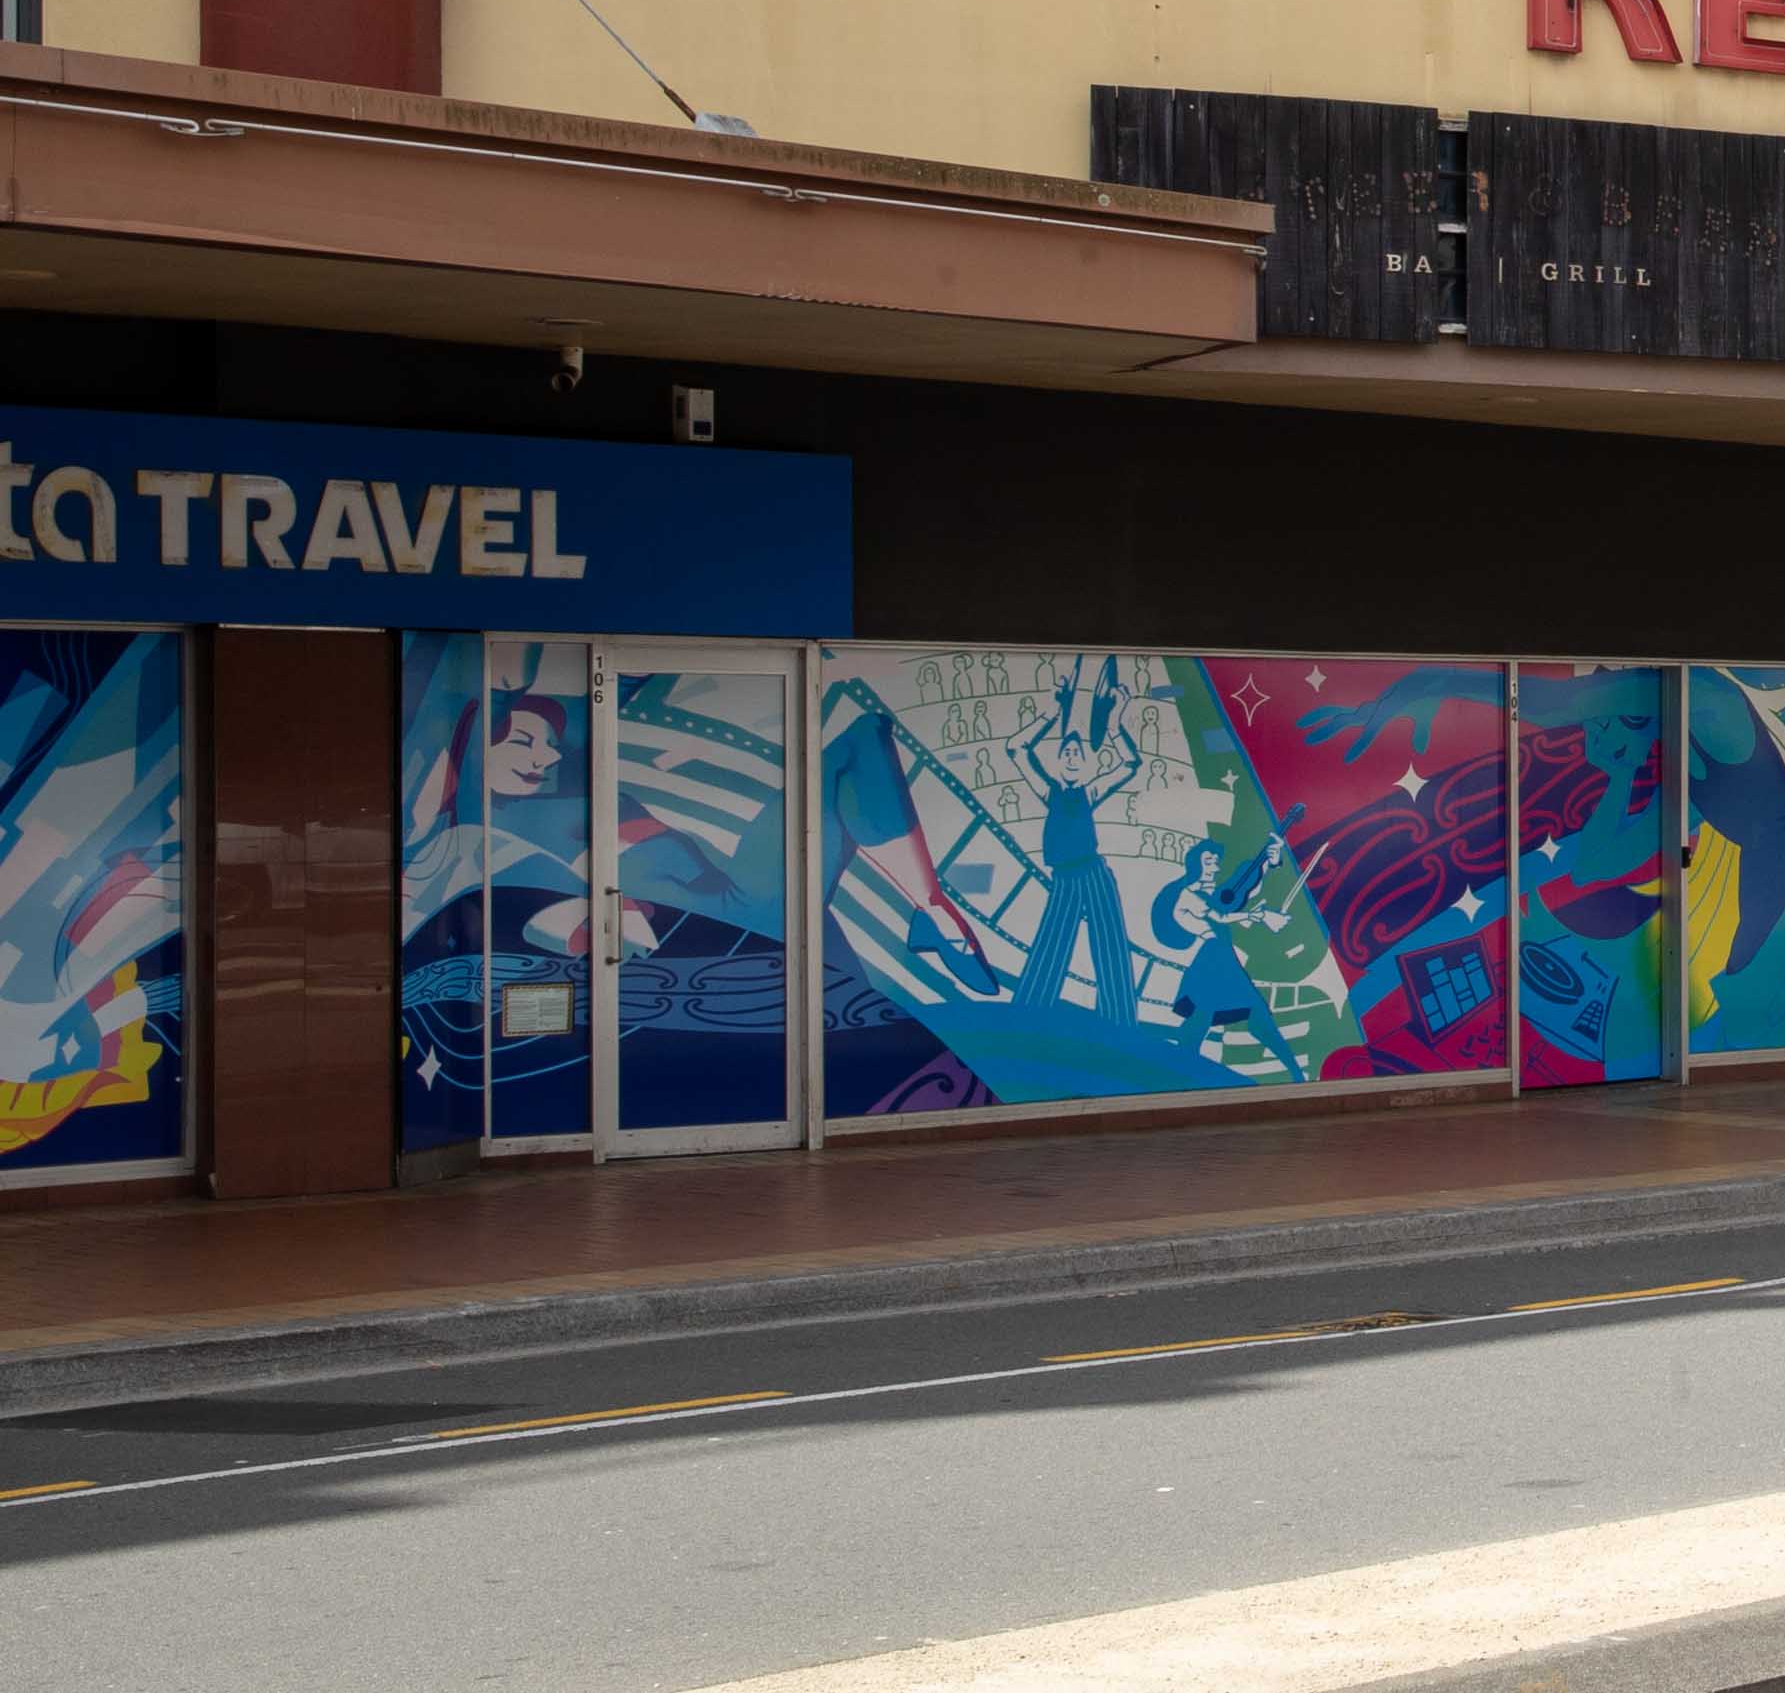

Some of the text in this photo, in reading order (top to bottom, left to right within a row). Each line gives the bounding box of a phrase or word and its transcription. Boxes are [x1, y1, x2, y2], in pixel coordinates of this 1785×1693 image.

[1540, 262, 1652, 287] GRILL
[136, 469, 588, 580] TRAVEL
[594, 654, 604, 704] 106
